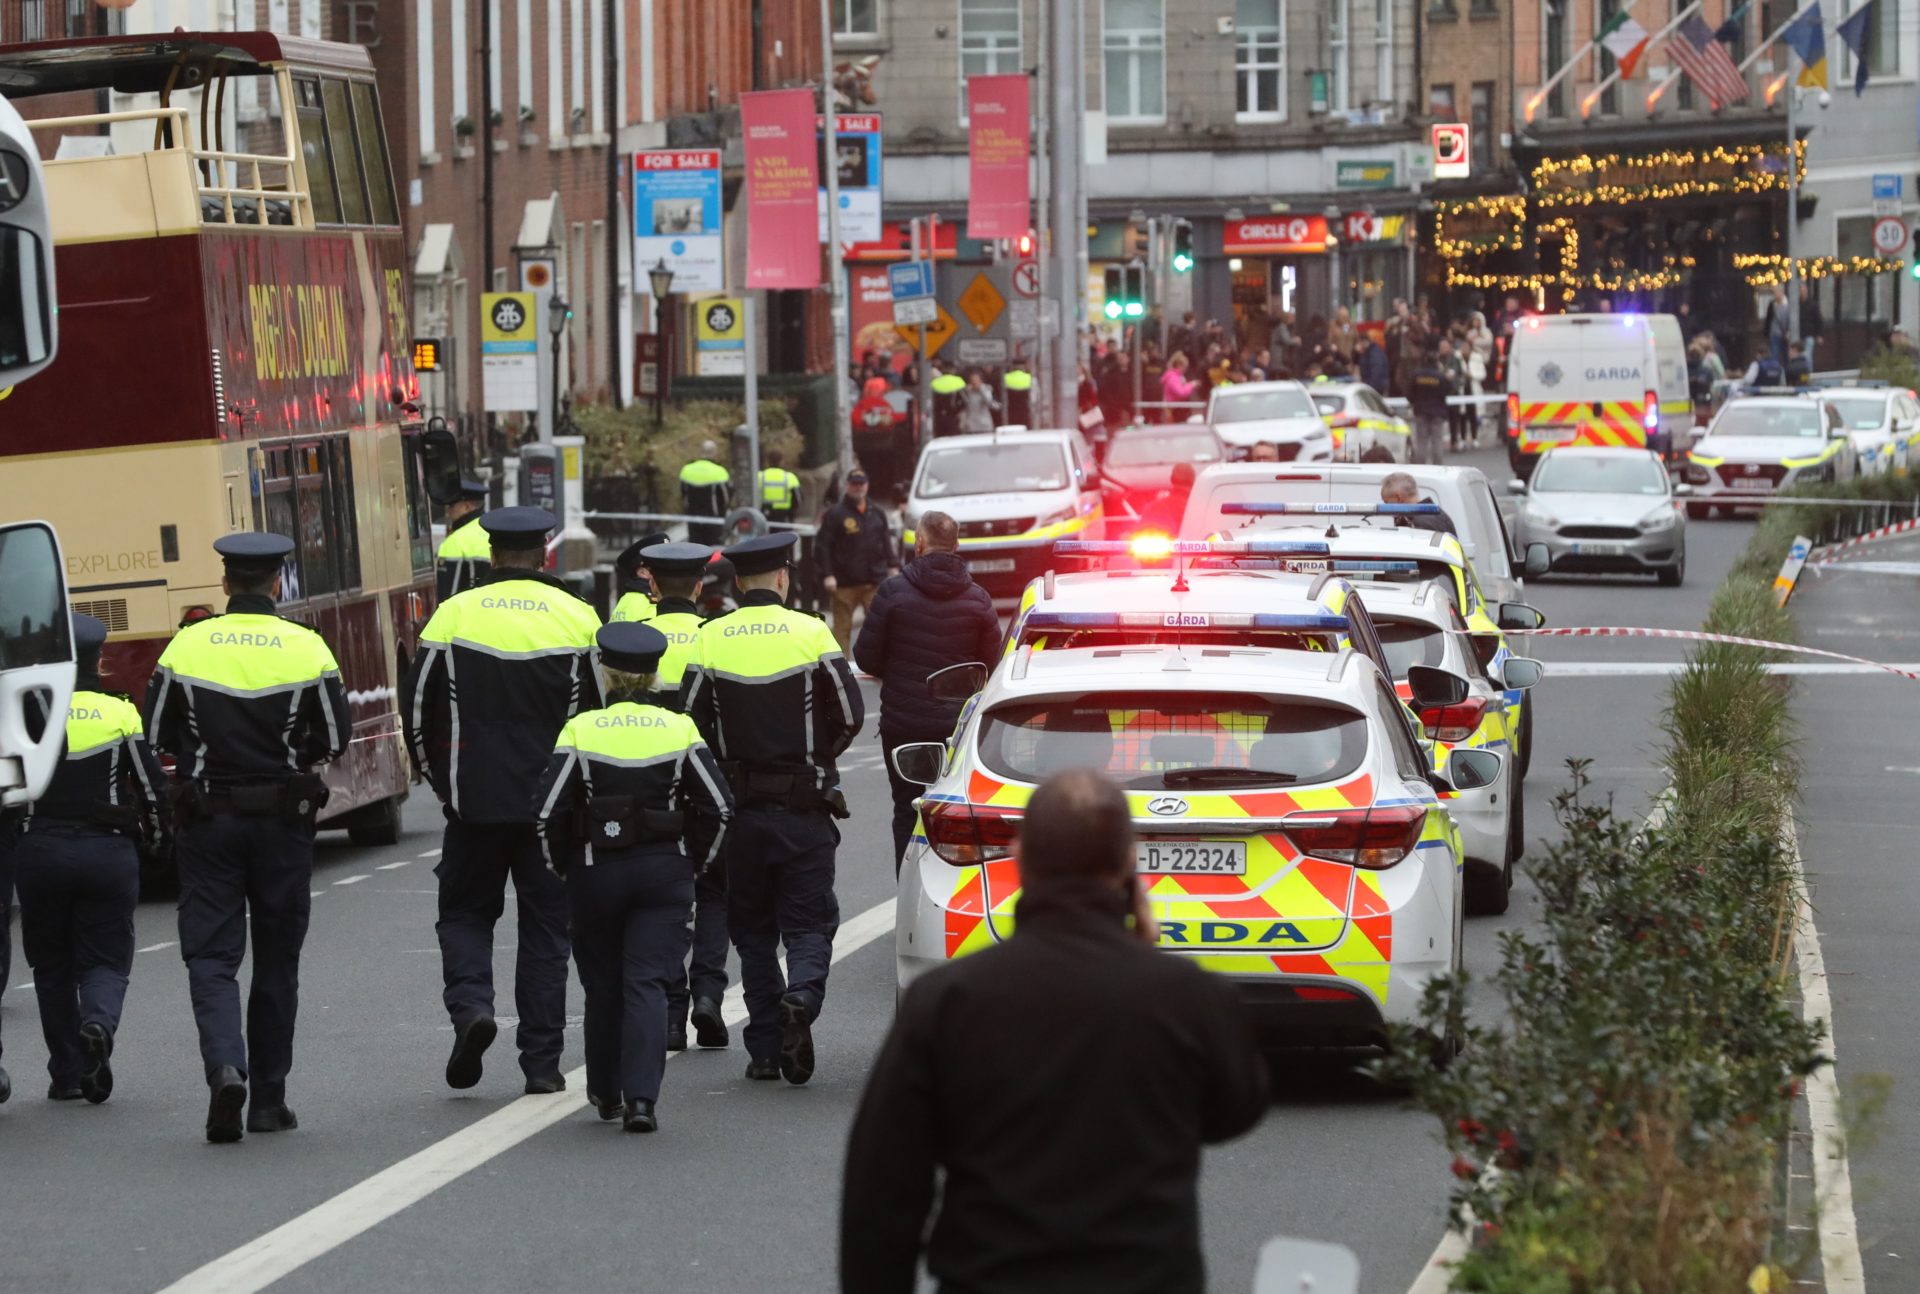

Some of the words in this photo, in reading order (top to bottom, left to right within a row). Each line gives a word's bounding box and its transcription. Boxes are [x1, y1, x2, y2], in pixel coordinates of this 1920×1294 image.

[846, 118, 872, 129] SALE
[643, 154, 673, 168] FOR
[678, 153, 711, 167] SALE
[1239, 223, 1286, 240] CIRCLE
[1585, 367, 1641, 381] GARDA
[1317, 504, 1345, 513] GARDA
[1174, 542, 1208, 552] GARDA
[66, 550, 160, 576] EXPLORE
[1287, 561, 1326, 571] GARDA
[480, 597, 550, 613] GARDA
[1166, 615, 1207, 626] GARDA
[723, 623, 790, 638] GARDA
[209, 632, 283, 649] GARDA
[664, 632, 698, 645] RDA
[67, 707, 103, 720] RDA
[595, 715, 668, 729] GARDA
[1138, 848, 1237, 871] -D-22324
[1155, 922, 1310, 943] RDA
